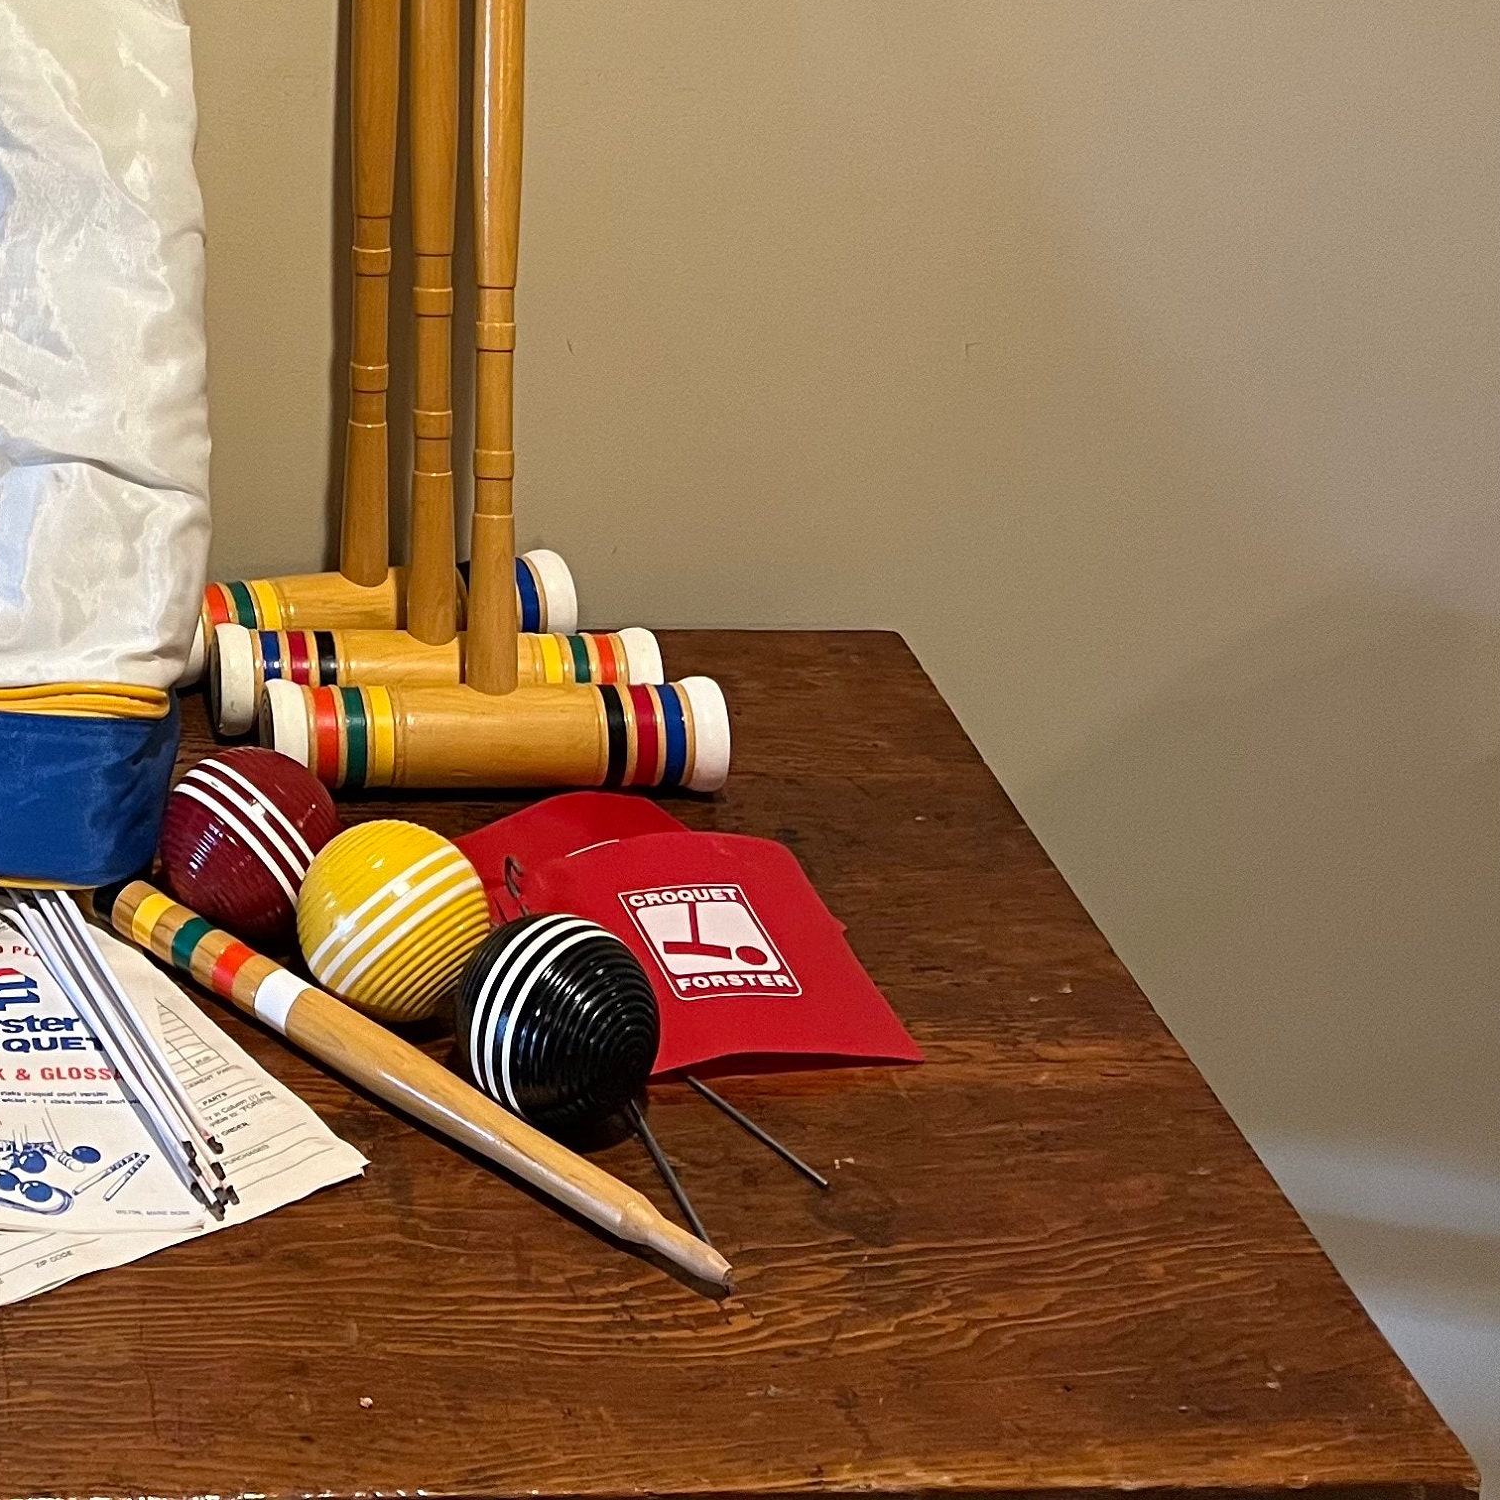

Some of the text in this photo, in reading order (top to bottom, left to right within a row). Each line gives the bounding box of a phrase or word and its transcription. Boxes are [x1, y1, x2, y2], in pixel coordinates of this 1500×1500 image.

[628, 887, 737, 907] CROQUET
[12, 945, 39, 957] PL
[675, 973, 794, 992] FORSTER
[15, 1067, 31, 1081] &
[40, 1066, 125, 1081] GLOSSA
[202, 1091, 228, 1106] PARTS
[49, 1250, 74, 1262] CODE
